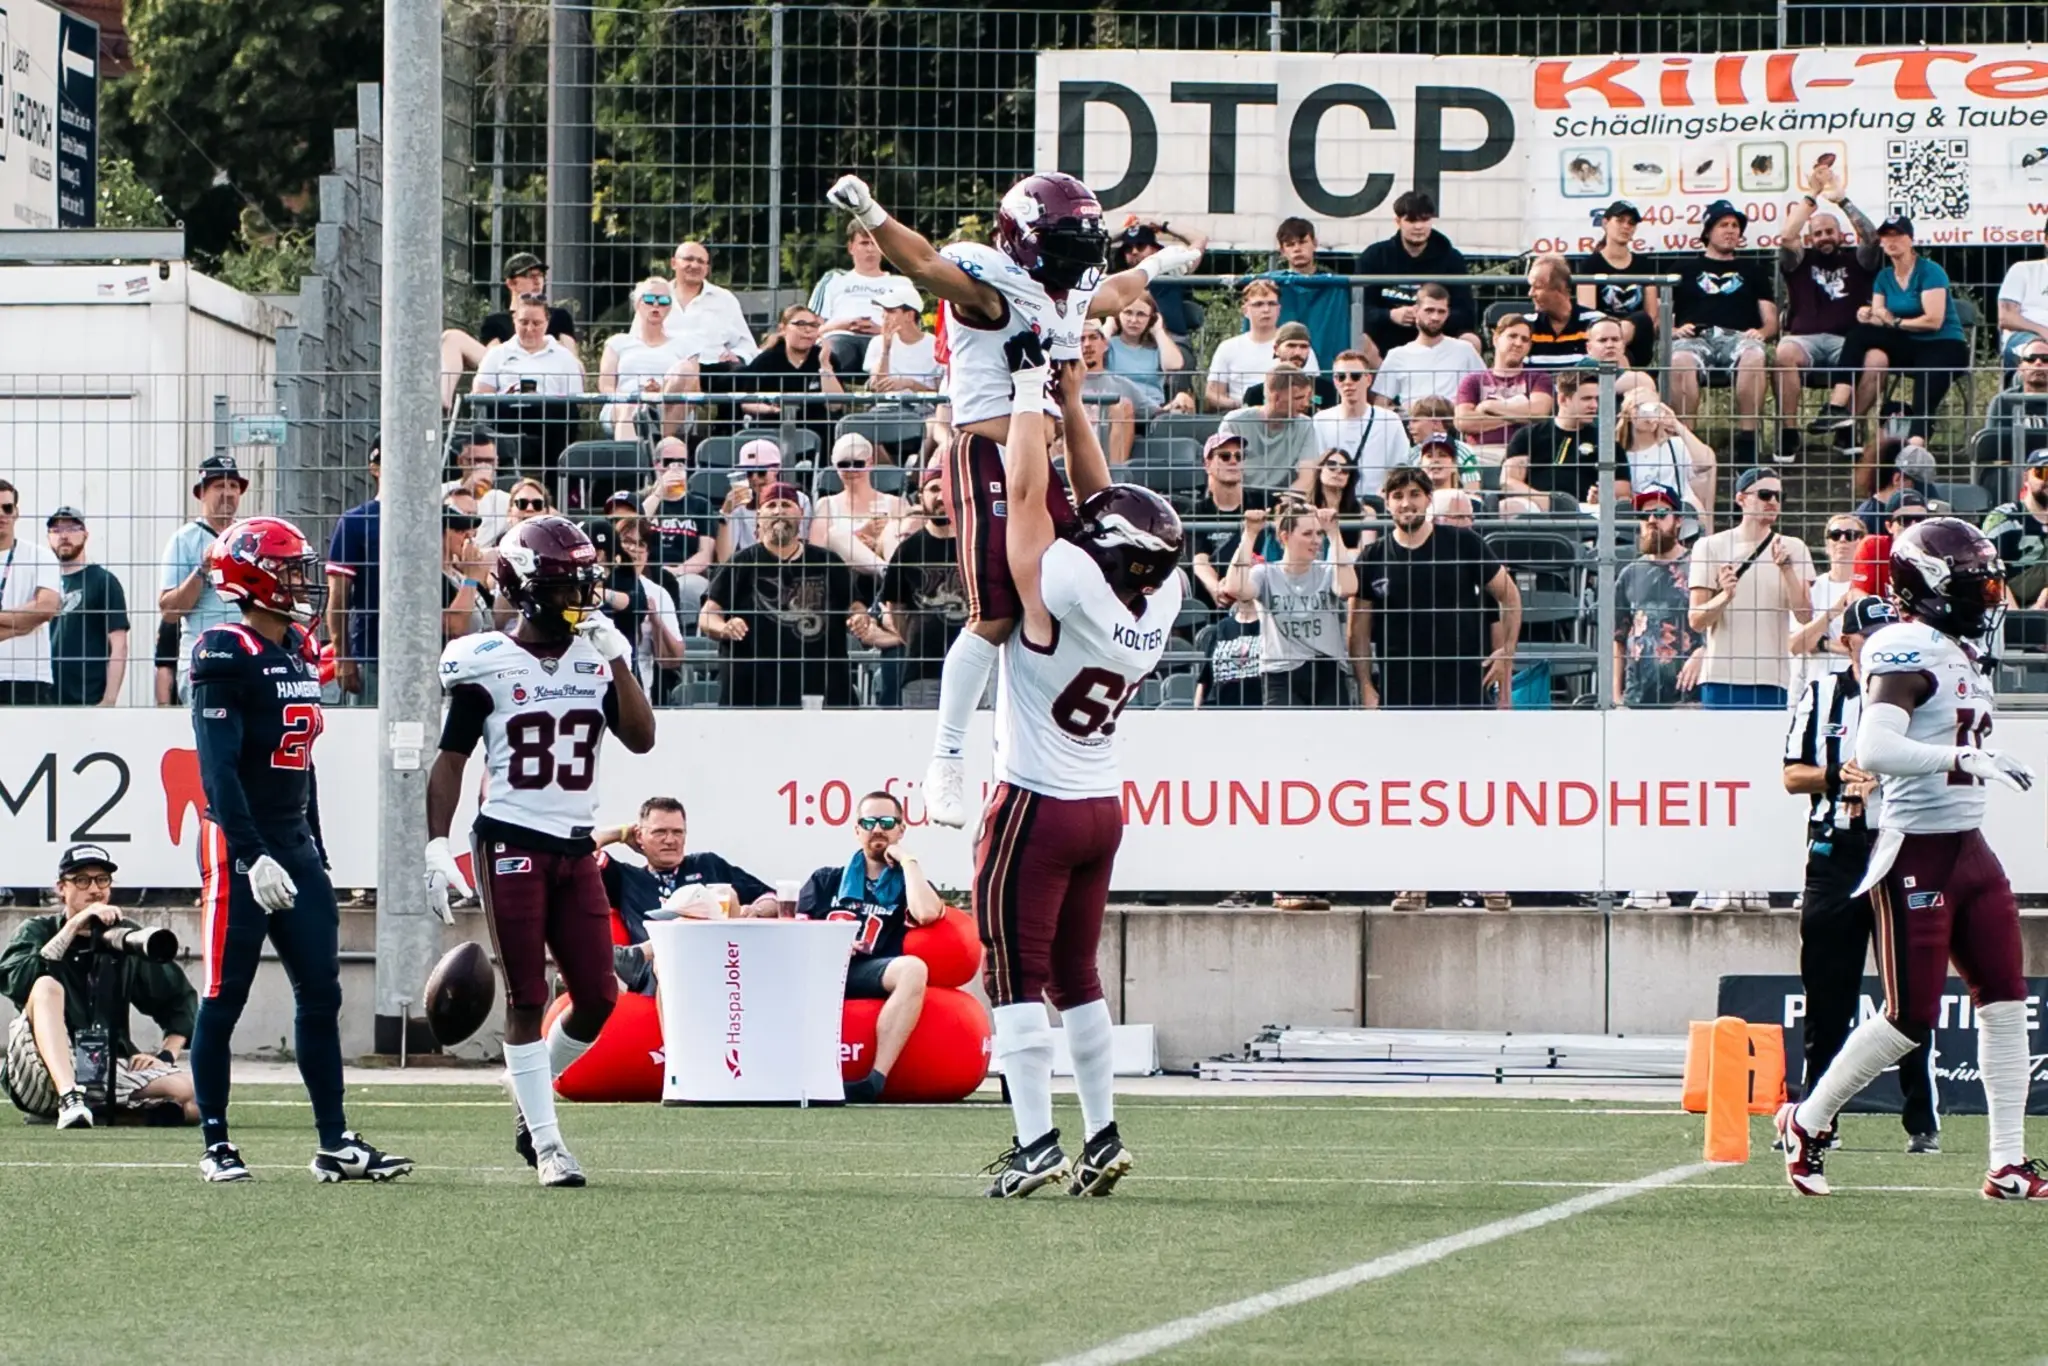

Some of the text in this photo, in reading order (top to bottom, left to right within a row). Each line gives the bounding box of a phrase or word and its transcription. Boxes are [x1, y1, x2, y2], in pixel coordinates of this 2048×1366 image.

[1058, 80, 1515, 219] DTCP
[1553, 108, 1915, 140] Schädlingsbekämpfung
[1926, 106, 1946, 127] &
[1113, 623, 1162, 651] KOLTER
[506, 709, 604, 791] 83
[777, 780, 852, 826] 1:0
[1121, 780, 1751, 827] MUNDGESUNDHEIT
[724, 941, 745, 1044] HaspaJoker
